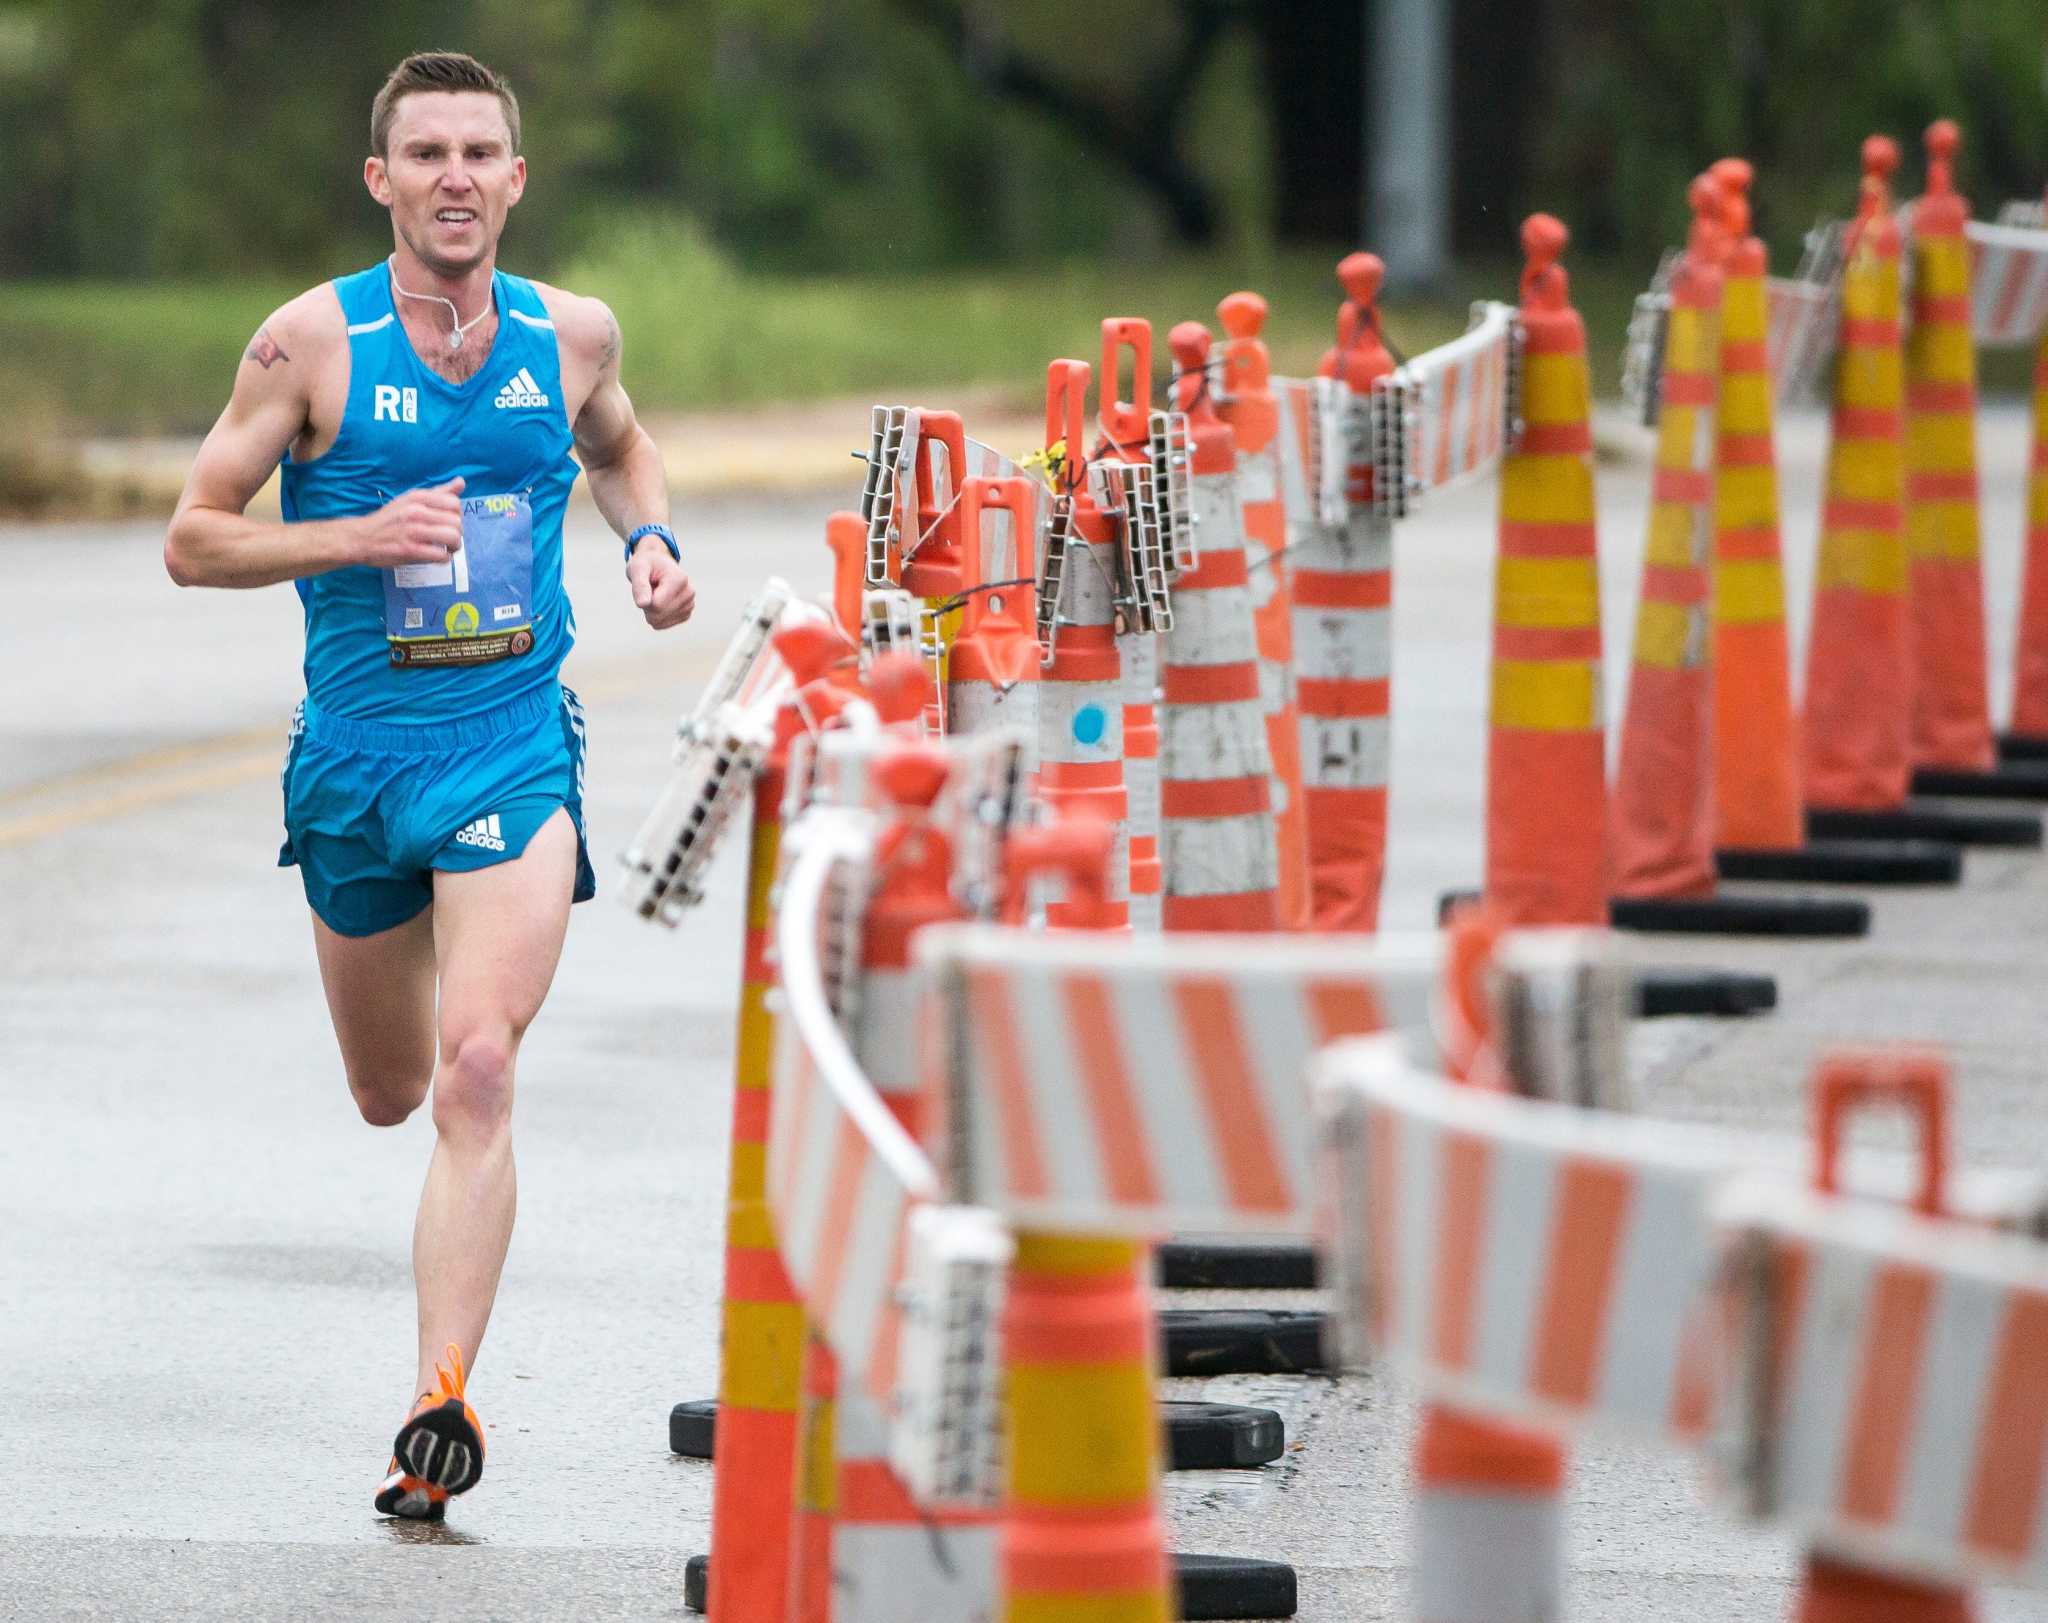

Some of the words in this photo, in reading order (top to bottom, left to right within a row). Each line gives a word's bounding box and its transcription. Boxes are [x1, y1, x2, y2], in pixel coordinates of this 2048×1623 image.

[494, 393, 549, 409] adidas
[463, 495, 517, 516] AP10K
[456, 831, 506, 852] adidas
